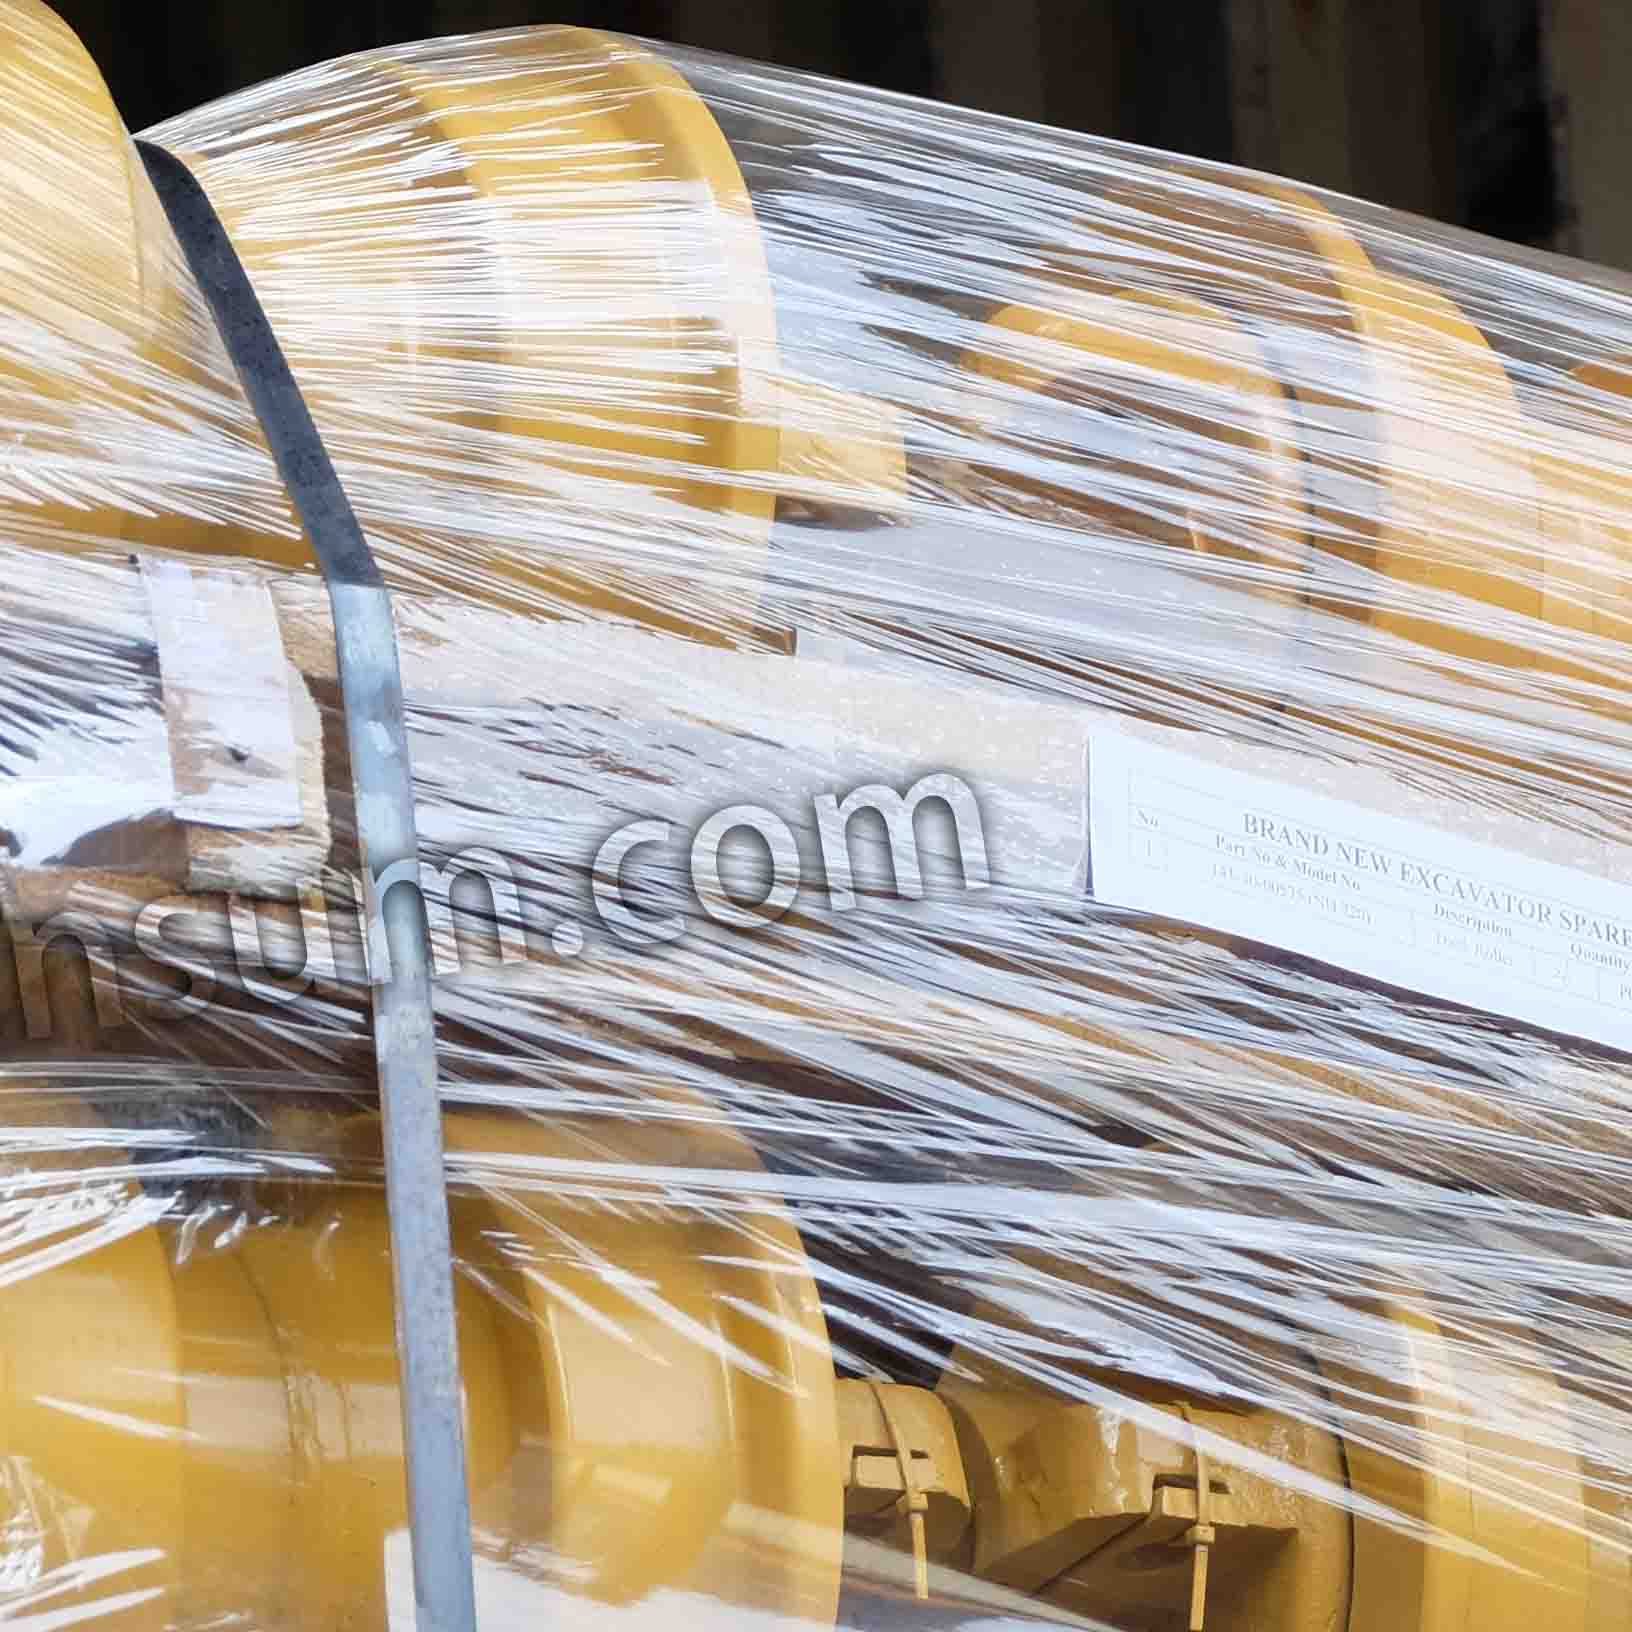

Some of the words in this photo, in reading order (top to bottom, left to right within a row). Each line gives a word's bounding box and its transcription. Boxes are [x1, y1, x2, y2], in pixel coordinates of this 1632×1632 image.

[1243, 811, 1330, 857] BRAND
[1336, 841, 1392, 875] NEW
[1400, 861, 1553, 925] EXCAVATOR
[1293, 857, 1337, 885] Model
[1569, 942, 1632, 976] Quantity
